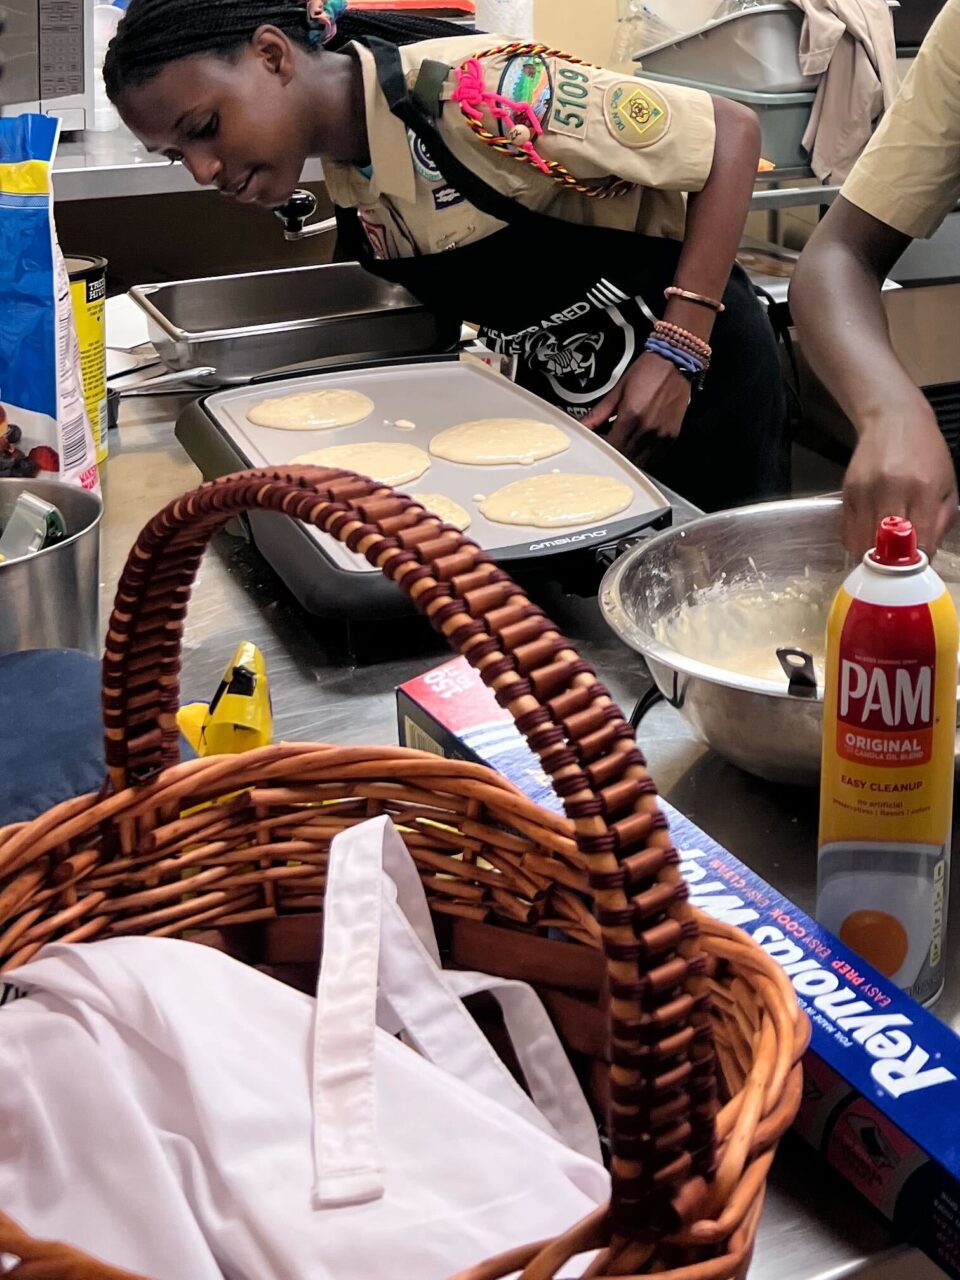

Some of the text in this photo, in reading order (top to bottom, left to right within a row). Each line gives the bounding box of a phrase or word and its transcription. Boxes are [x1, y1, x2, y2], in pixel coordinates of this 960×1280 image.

[554, 68, 590, 129] 5109
[840, 658, 932, 726] PAM
[845, 733, 921, 752] ORIGINAL
[841, 774, 924, 793] EASY CLEANUP
[804, 934, 831, 959] EASY
[861, 983, 891, 1008] EASY
[751, 926, 957, 1099] Reynolds
